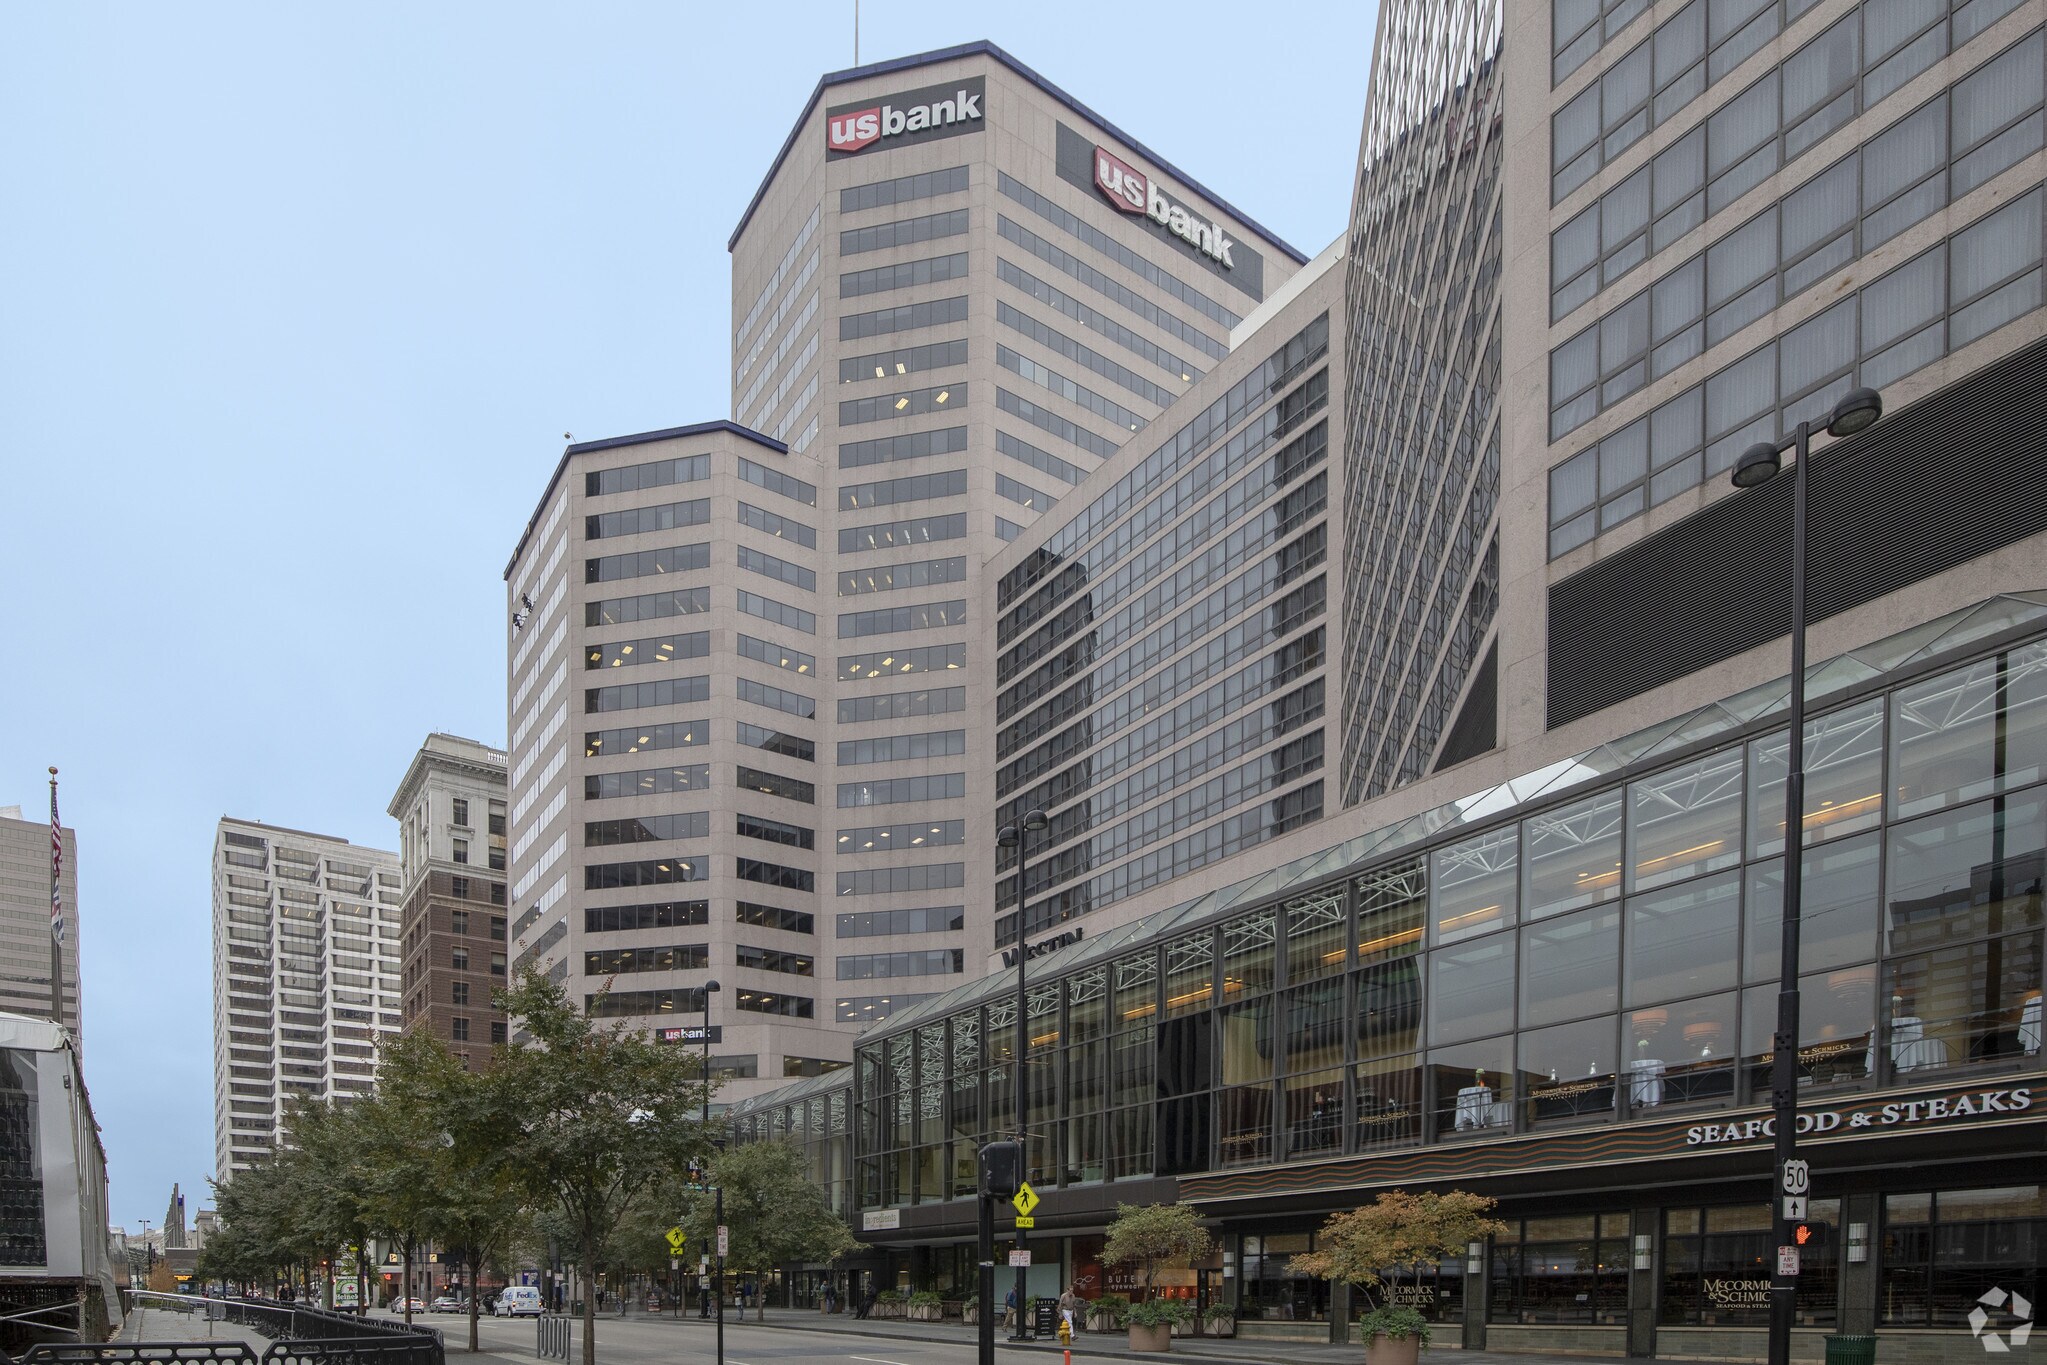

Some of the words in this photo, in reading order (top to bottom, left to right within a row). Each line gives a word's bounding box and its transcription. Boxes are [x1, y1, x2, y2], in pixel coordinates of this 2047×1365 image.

[1849, 1112, 1872, 1128] &
[1881, 1088, 2033, 1125] STEAKS
[1786, 1166, 1806, 1188] 50
[1108, 1275, 1145, 1283] BUTEN
[516, 1291, 537, 1299] FedEx
